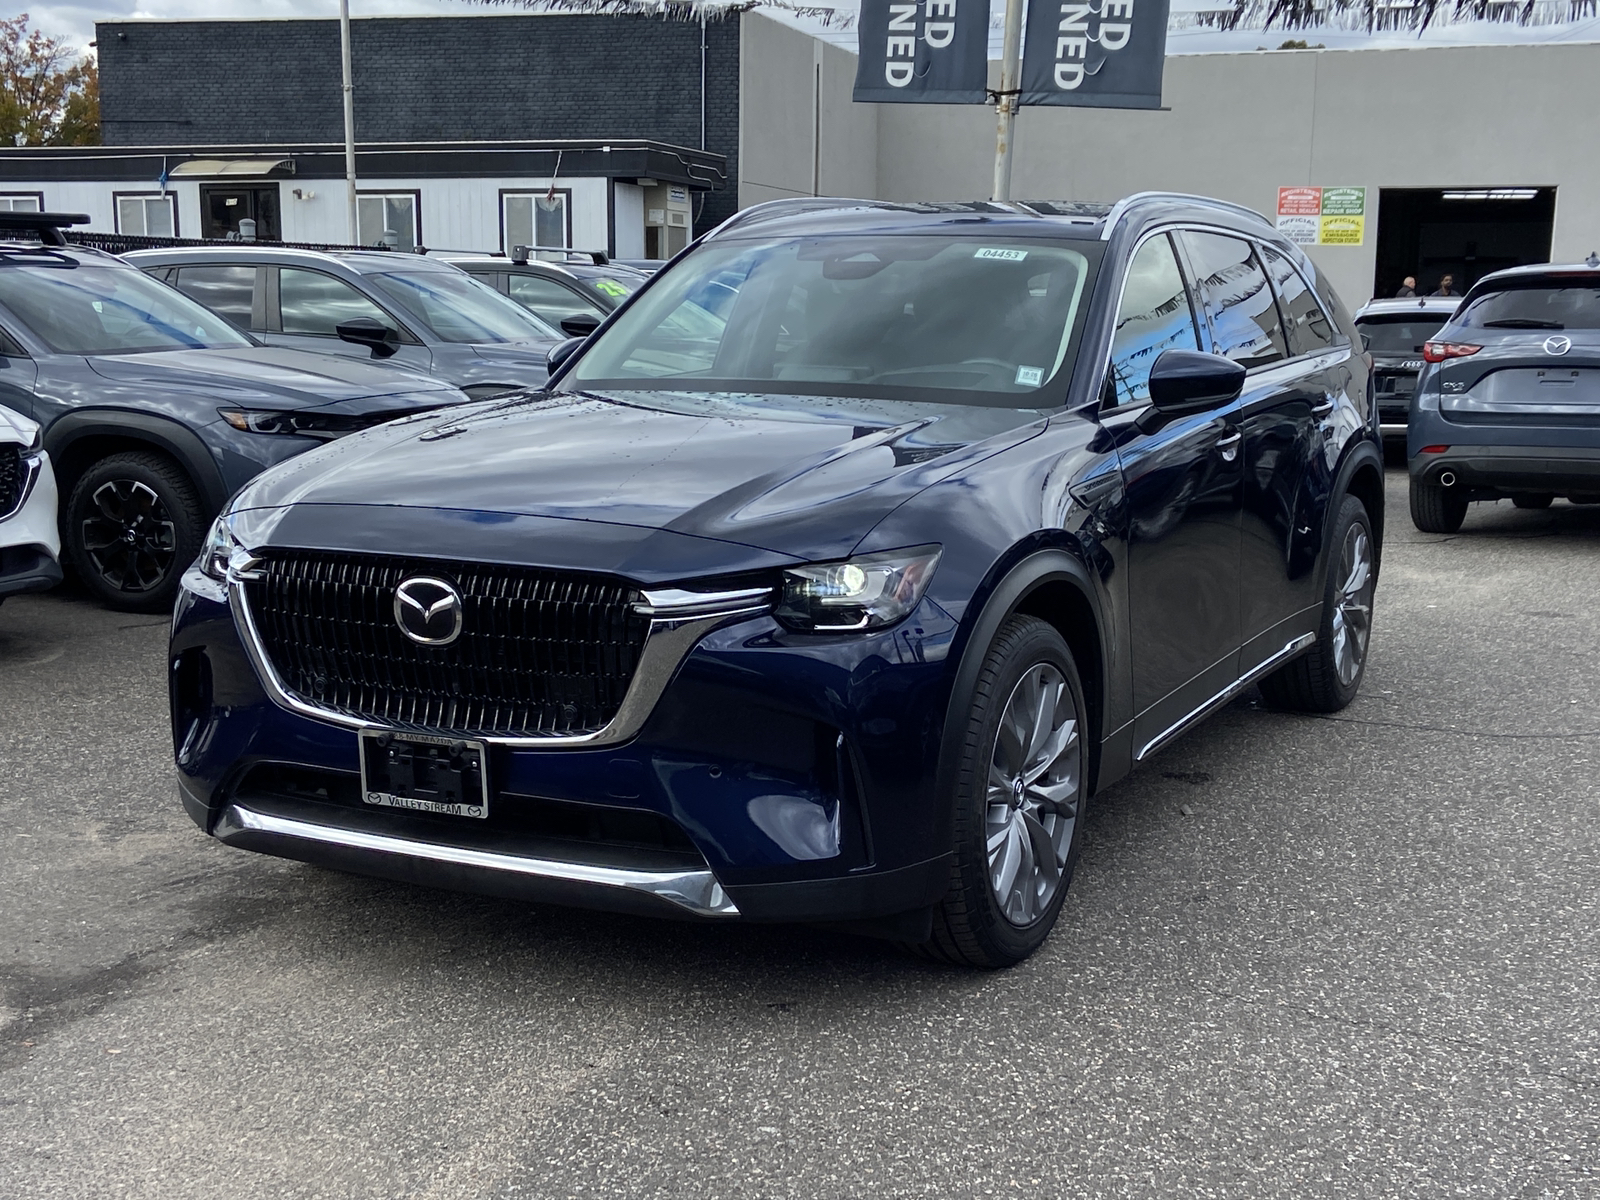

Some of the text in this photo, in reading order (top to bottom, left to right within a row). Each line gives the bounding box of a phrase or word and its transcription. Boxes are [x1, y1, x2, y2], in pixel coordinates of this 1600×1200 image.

[924, 0, 957, 48] ED
[1099, 0, 1134, 50] ED
[885, 0, 918, 88] NED
[1054, 0, 1091, 90] NED
[1280, 188, 1320, 198] REGISTERED
[1324, 188, 1363, 198] REGISTERED
[1279, 217, 1317, 227] OFFICIAL
[1323, 217, 1361, 227] OFFICIAL
[983, 249, 1019, 259] 04453
[596, 281, 627, 297] 25
[387, 795, 462, 815] VALLEY STREAM
